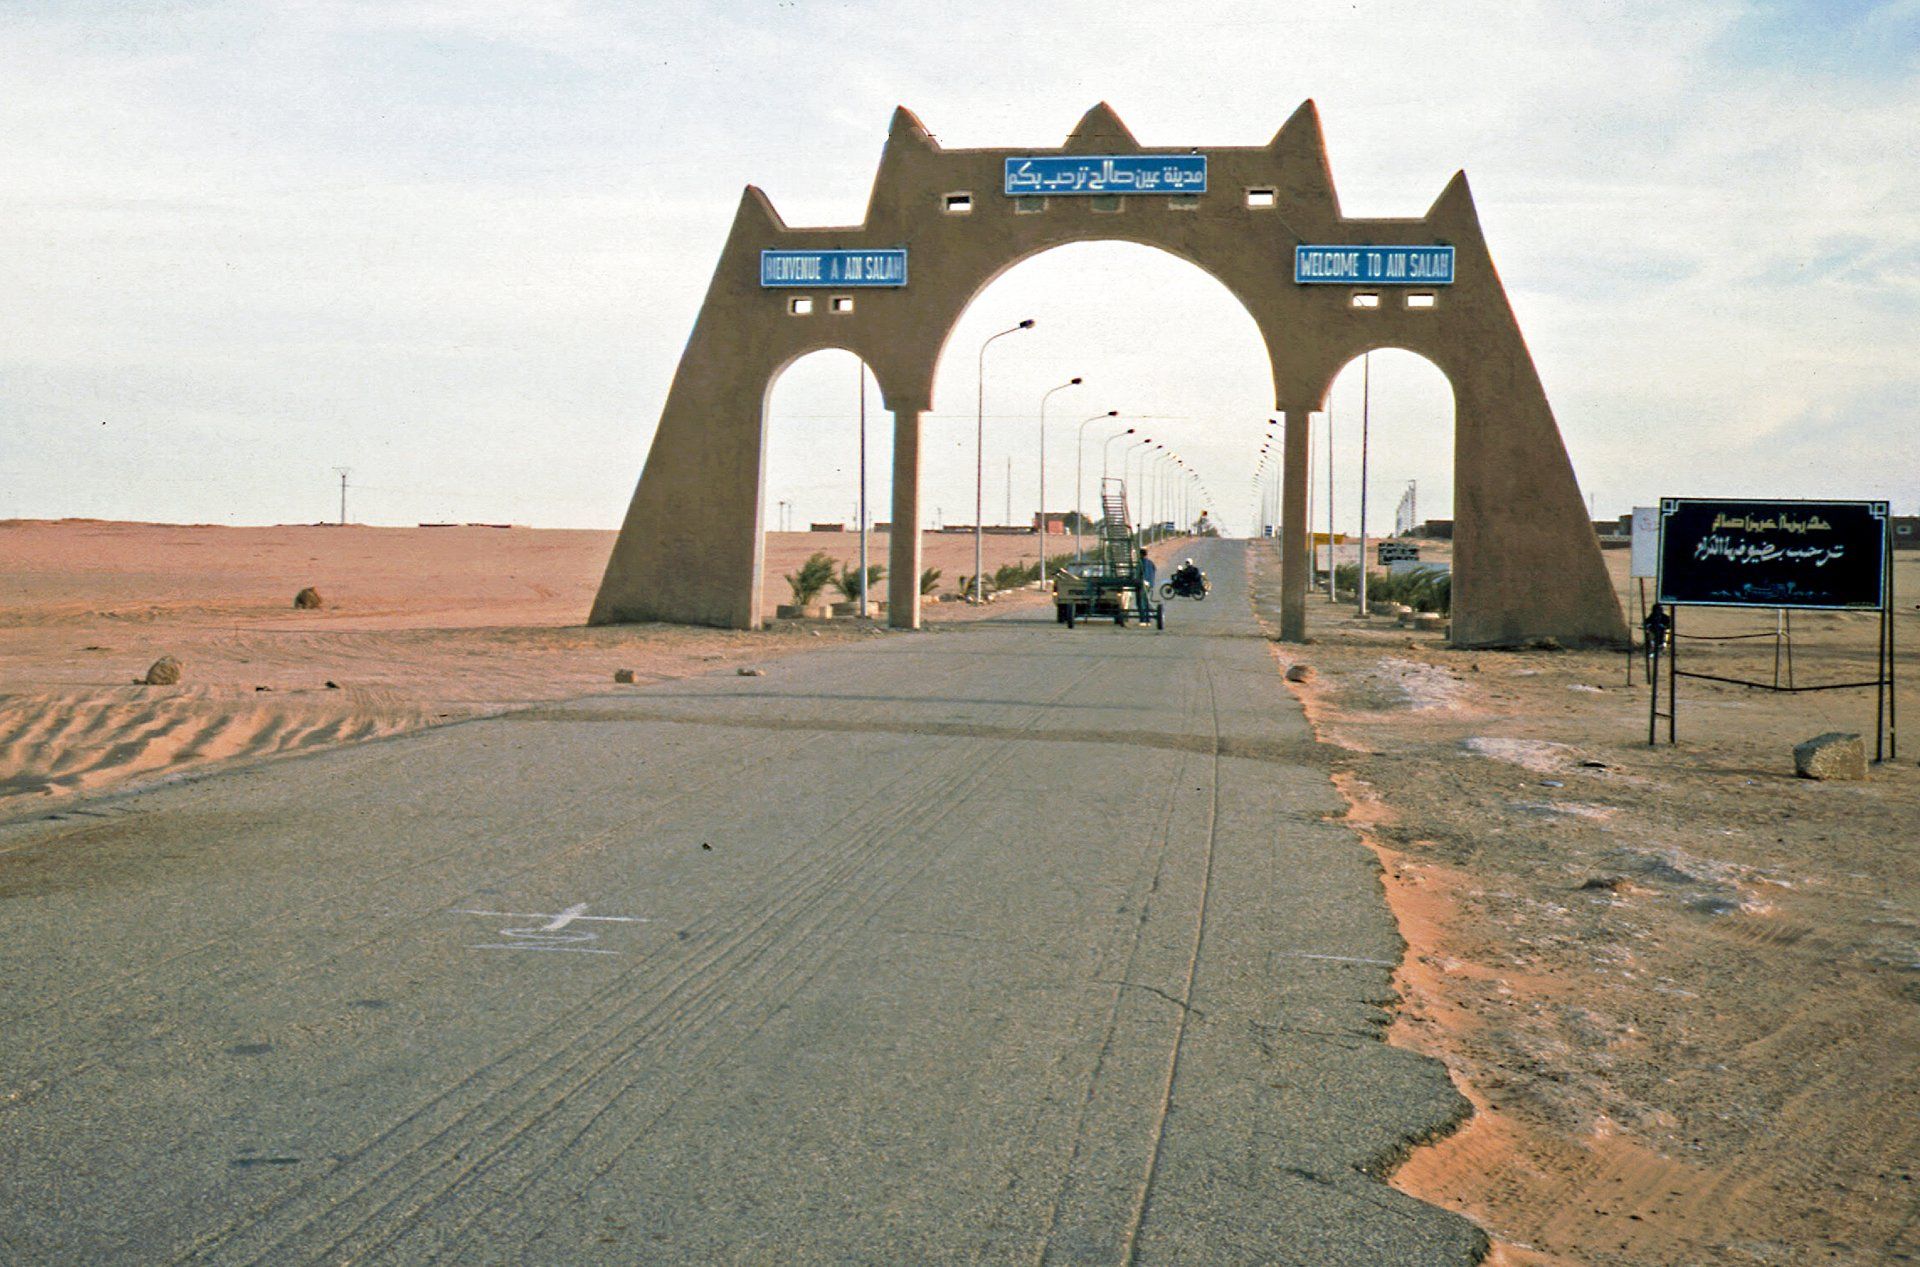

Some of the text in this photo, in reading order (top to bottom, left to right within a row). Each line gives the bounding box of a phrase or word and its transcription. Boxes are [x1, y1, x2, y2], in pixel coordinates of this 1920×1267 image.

[1008, 160, 1203, 191] مدينة عين صالح ترحب بكم
[766, 256, 821, 280] BIENVENUE
[844, 256, 862, 280] AIN
[865, 256, 903, 280] SALAH
[1301, 252, 1449, 277] WELCOME TO AIN SALAH
[1724, 537, 1786, 564] بضيوفها
[1787, 543, 1845, 567] ترحب
